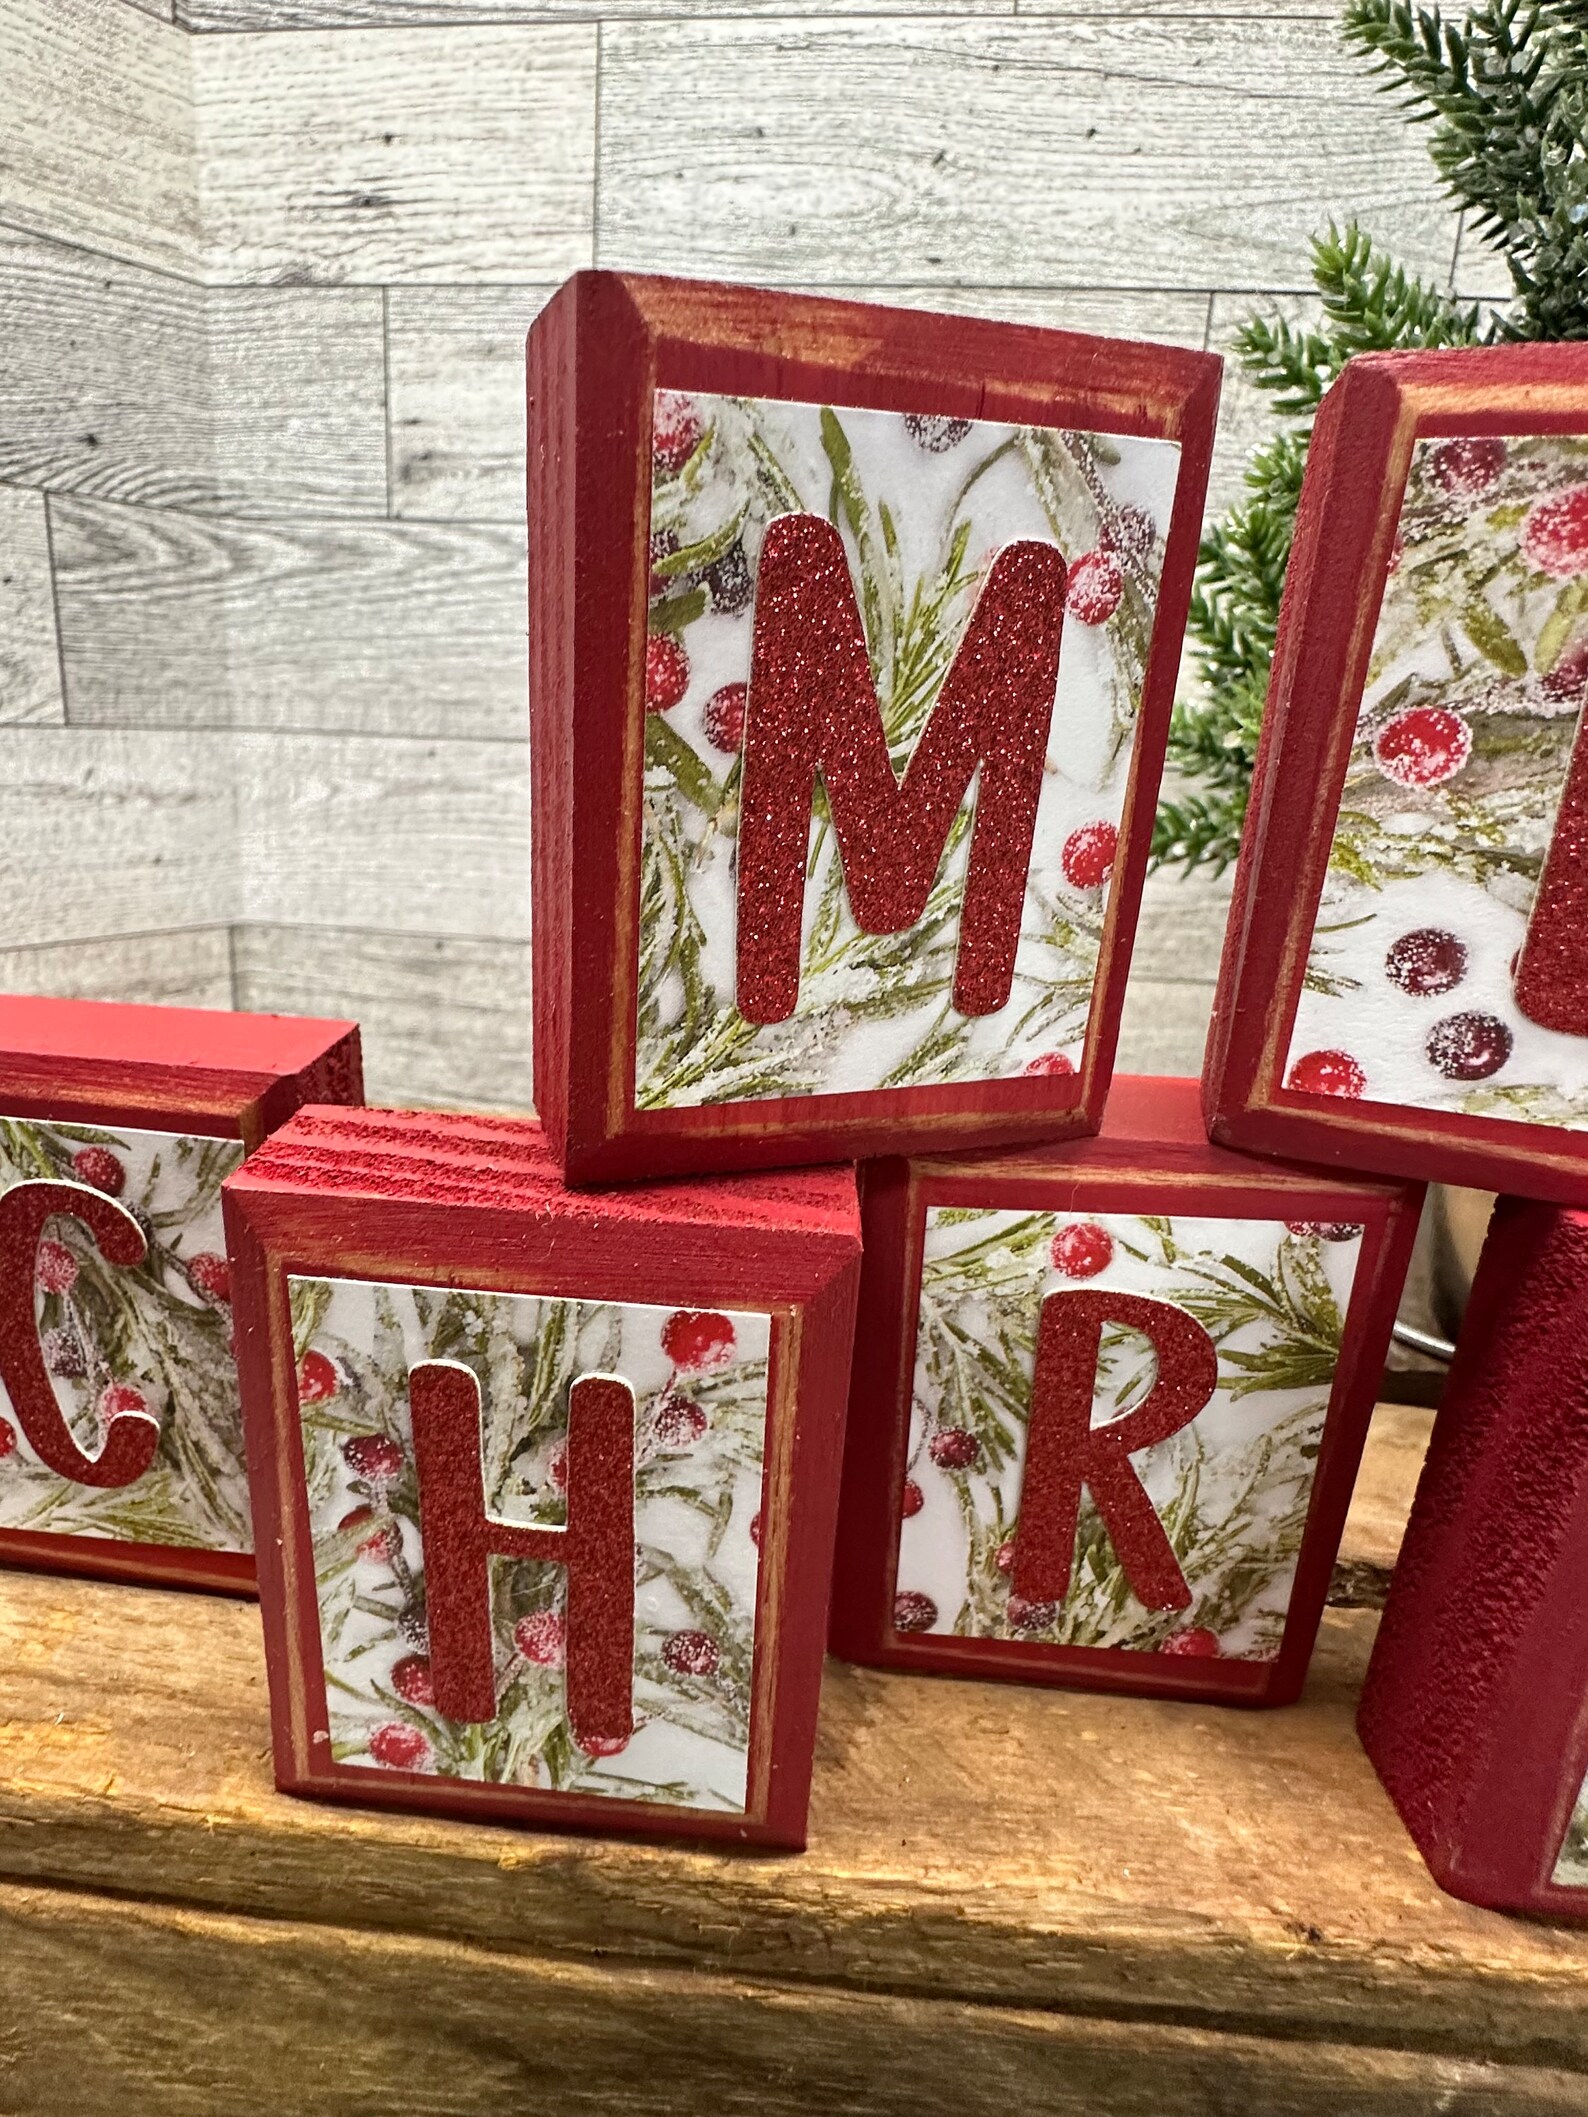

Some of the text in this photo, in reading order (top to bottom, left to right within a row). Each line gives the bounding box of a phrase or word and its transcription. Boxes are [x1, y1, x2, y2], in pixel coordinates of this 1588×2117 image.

[735, 511, 1068, 1024] M
[0, 1180, 160, 1488] C
[1011, 1288, 1218, 1612] R
[408, 1359, 636, 1741] H
